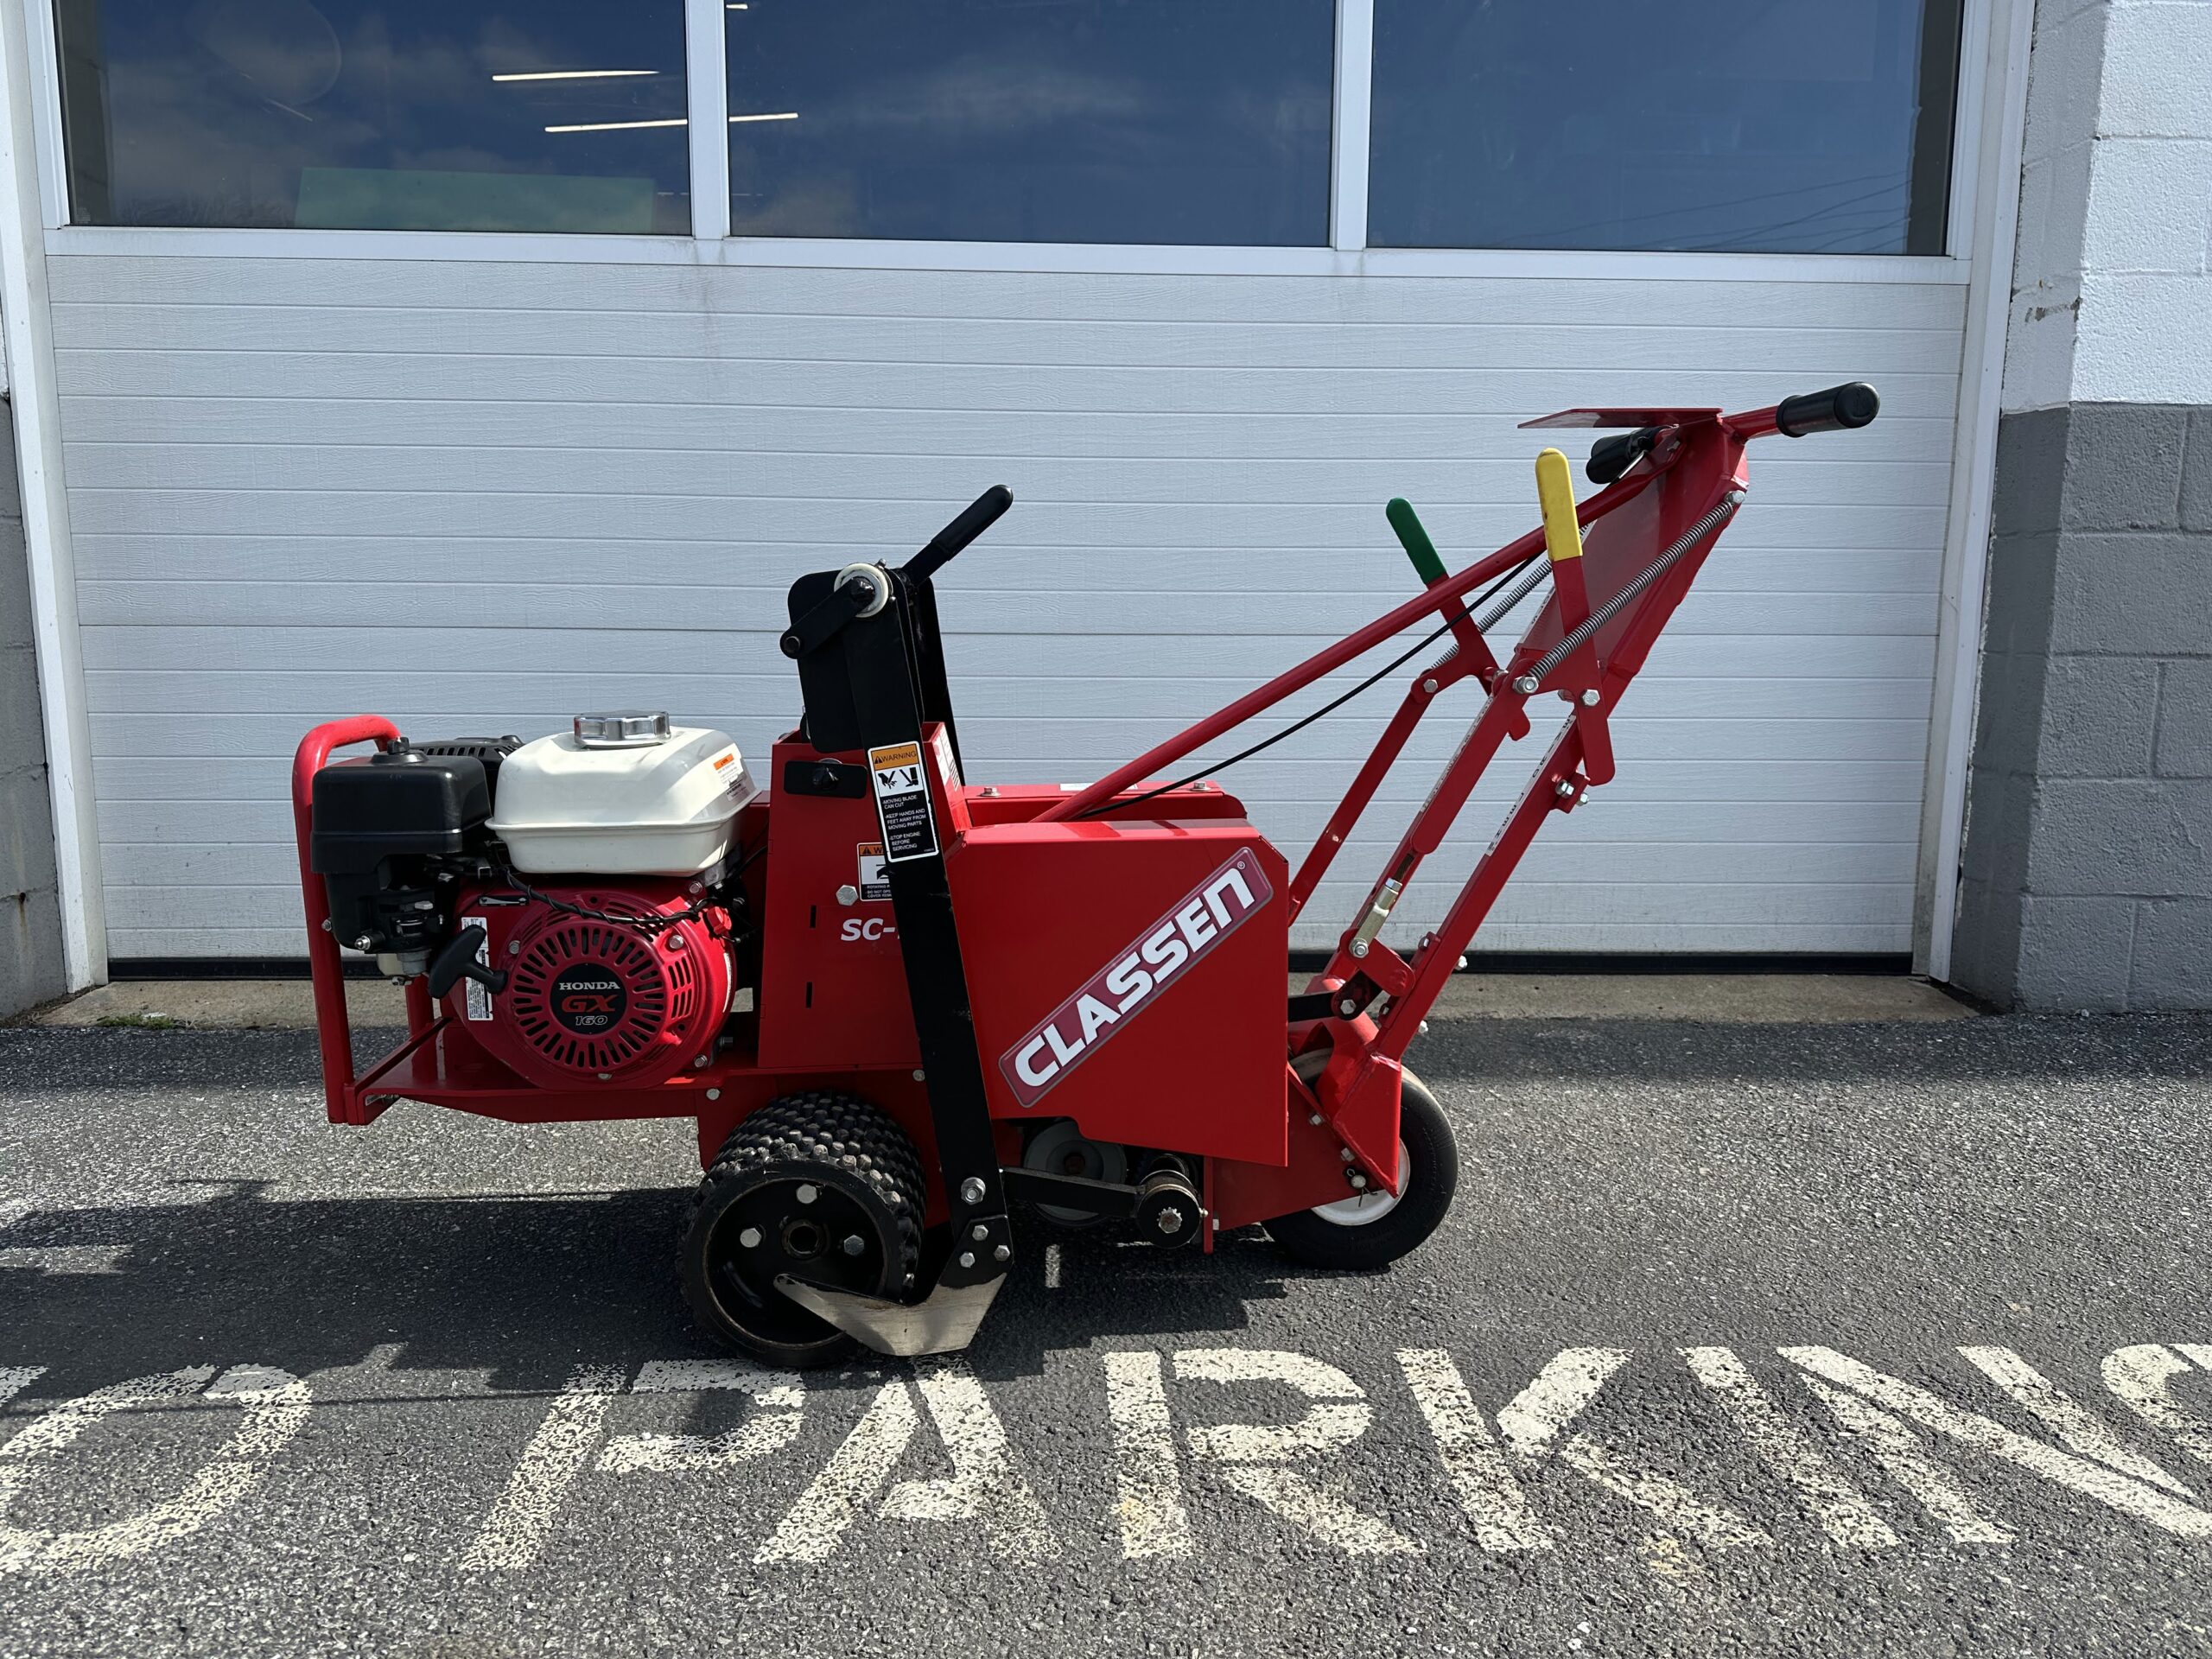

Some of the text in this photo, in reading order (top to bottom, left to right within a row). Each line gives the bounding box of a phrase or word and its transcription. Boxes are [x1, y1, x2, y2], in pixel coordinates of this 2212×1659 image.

[881, 751, 917, 763] WARNING
[893, 843, 918, 852] SERVICING
[840, 918, 900, 942] SC-
[558, 981, 620, 990] HONDA
[562, 995, 620, 1013] GX
[575, 1014, 608, 1026] 160
